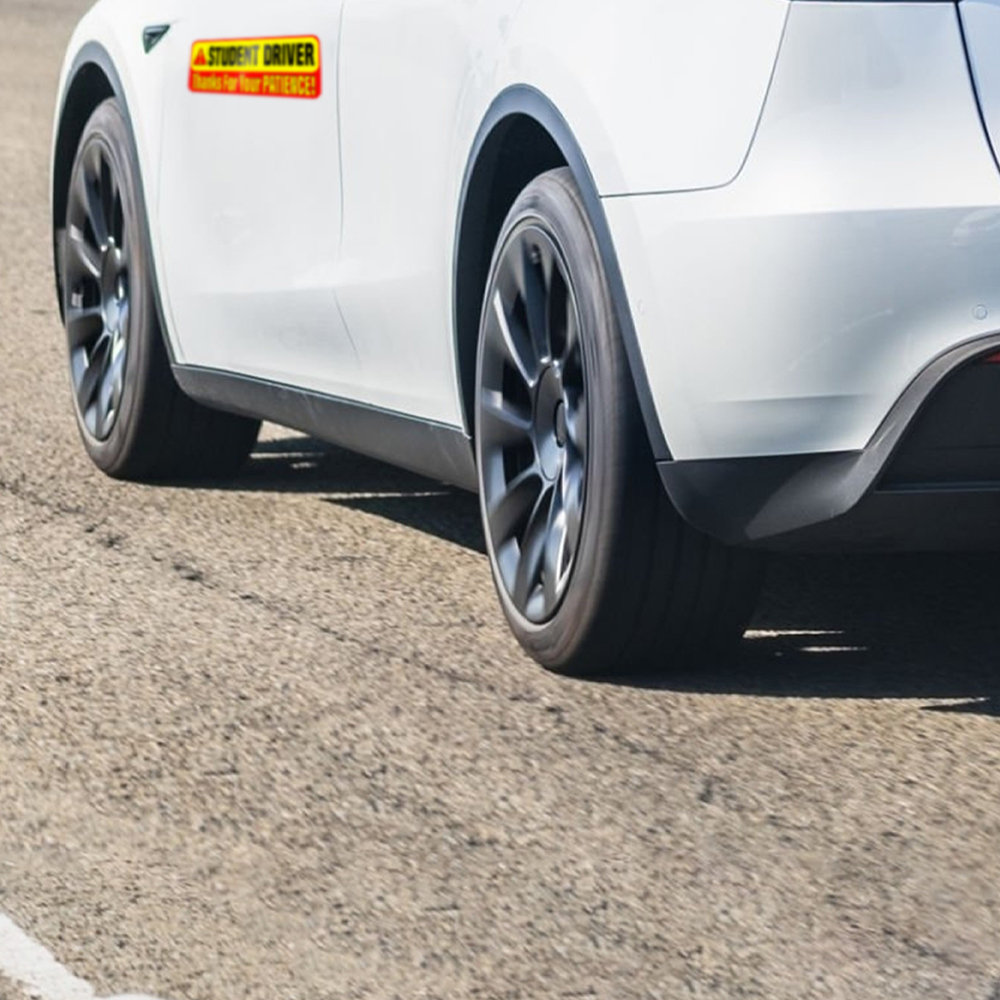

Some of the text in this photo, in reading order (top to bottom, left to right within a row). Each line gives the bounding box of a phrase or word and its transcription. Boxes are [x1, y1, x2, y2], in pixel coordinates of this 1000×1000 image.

[208, 42, 315, 67] STUDENT DRIVER
[192, 73, 316, 96] Thanks For Your PATIENCE!
